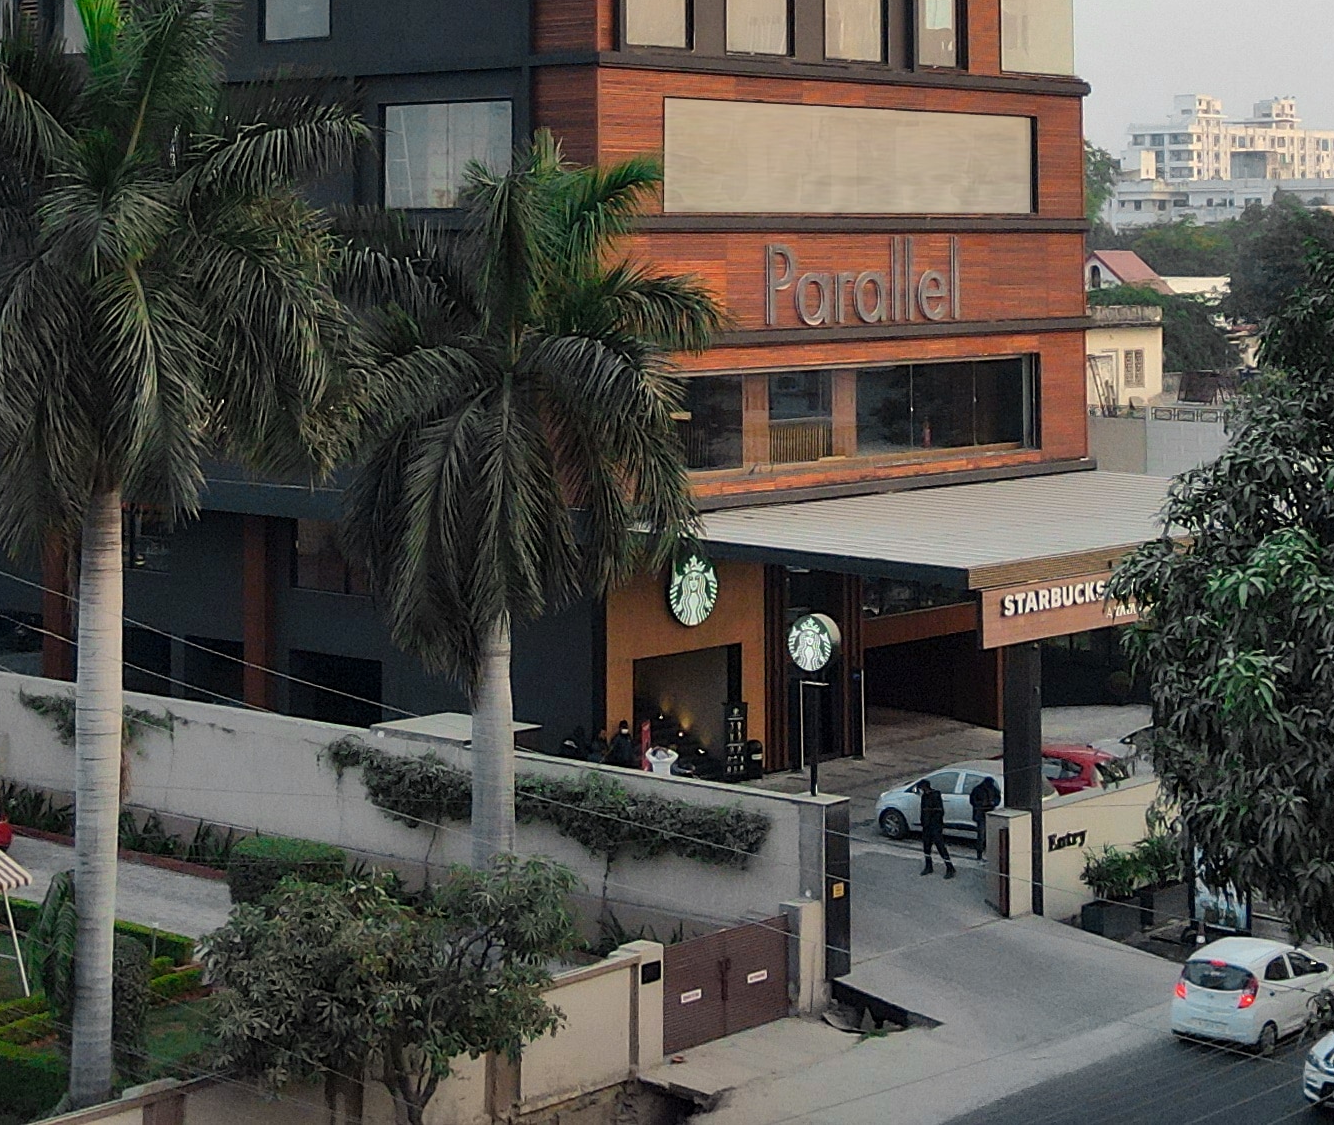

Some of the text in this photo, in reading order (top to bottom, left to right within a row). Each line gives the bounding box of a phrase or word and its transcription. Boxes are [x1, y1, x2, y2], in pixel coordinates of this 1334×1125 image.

[765, 235, 961, 325] Parallel
[1003, 579, 1107, 617] STARBUCKS
[1047, 829, 1087, 853] Entry
